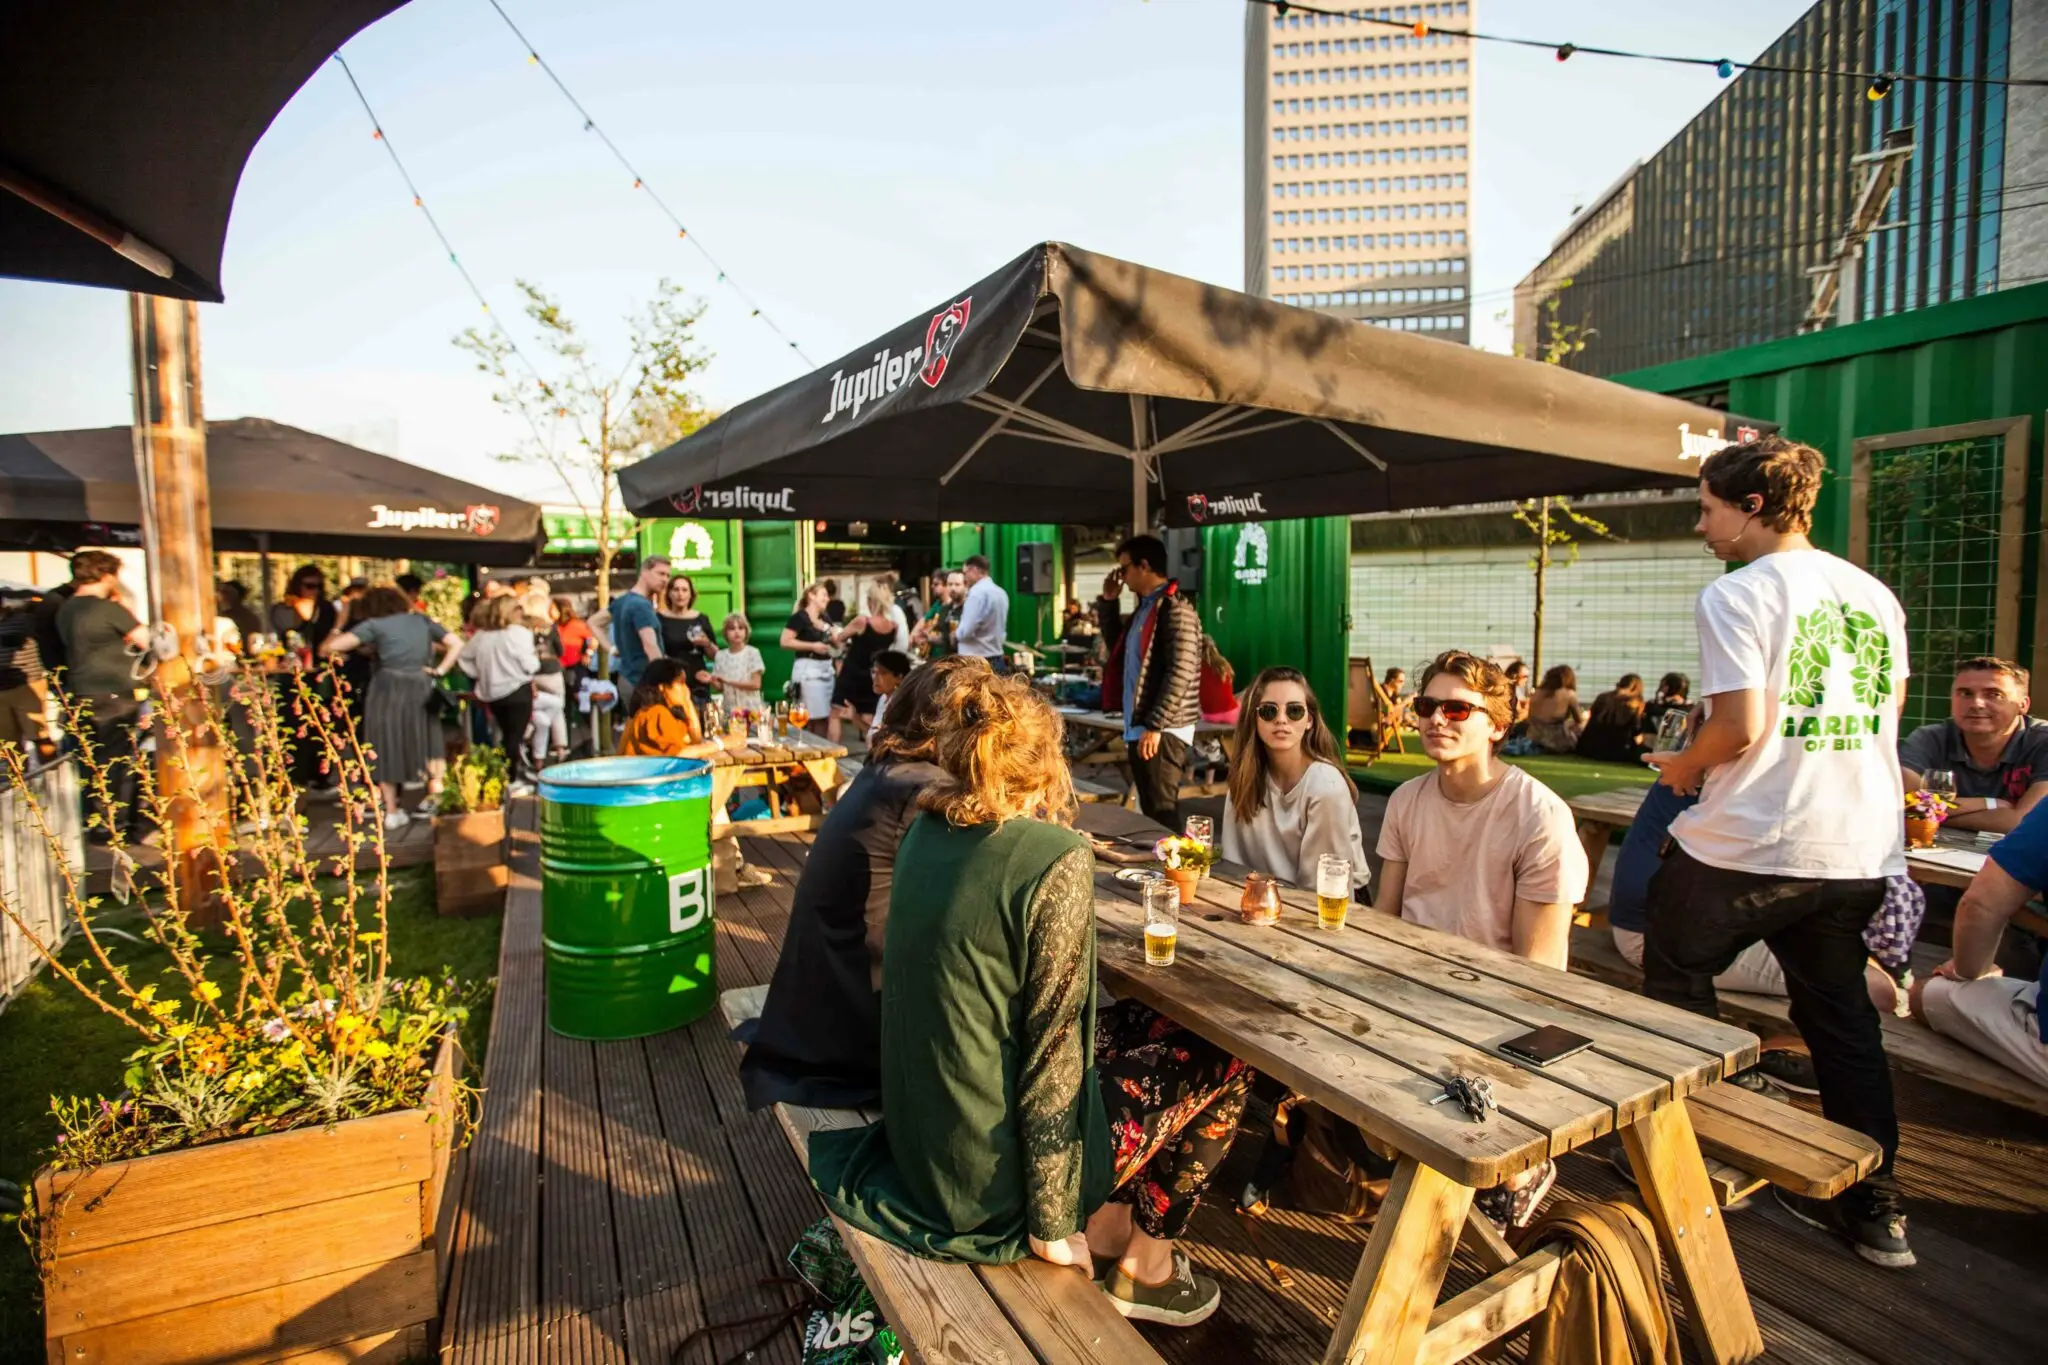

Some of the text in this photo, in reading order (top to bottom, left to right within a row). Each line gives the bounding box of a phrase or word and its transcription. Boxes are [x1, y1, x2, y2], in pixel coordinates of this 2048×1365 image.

[821, 346, 923, 424] Jupiler
[366, 504, 467, 532] Jupiler
[1804, 739, 1826, 753] OF
